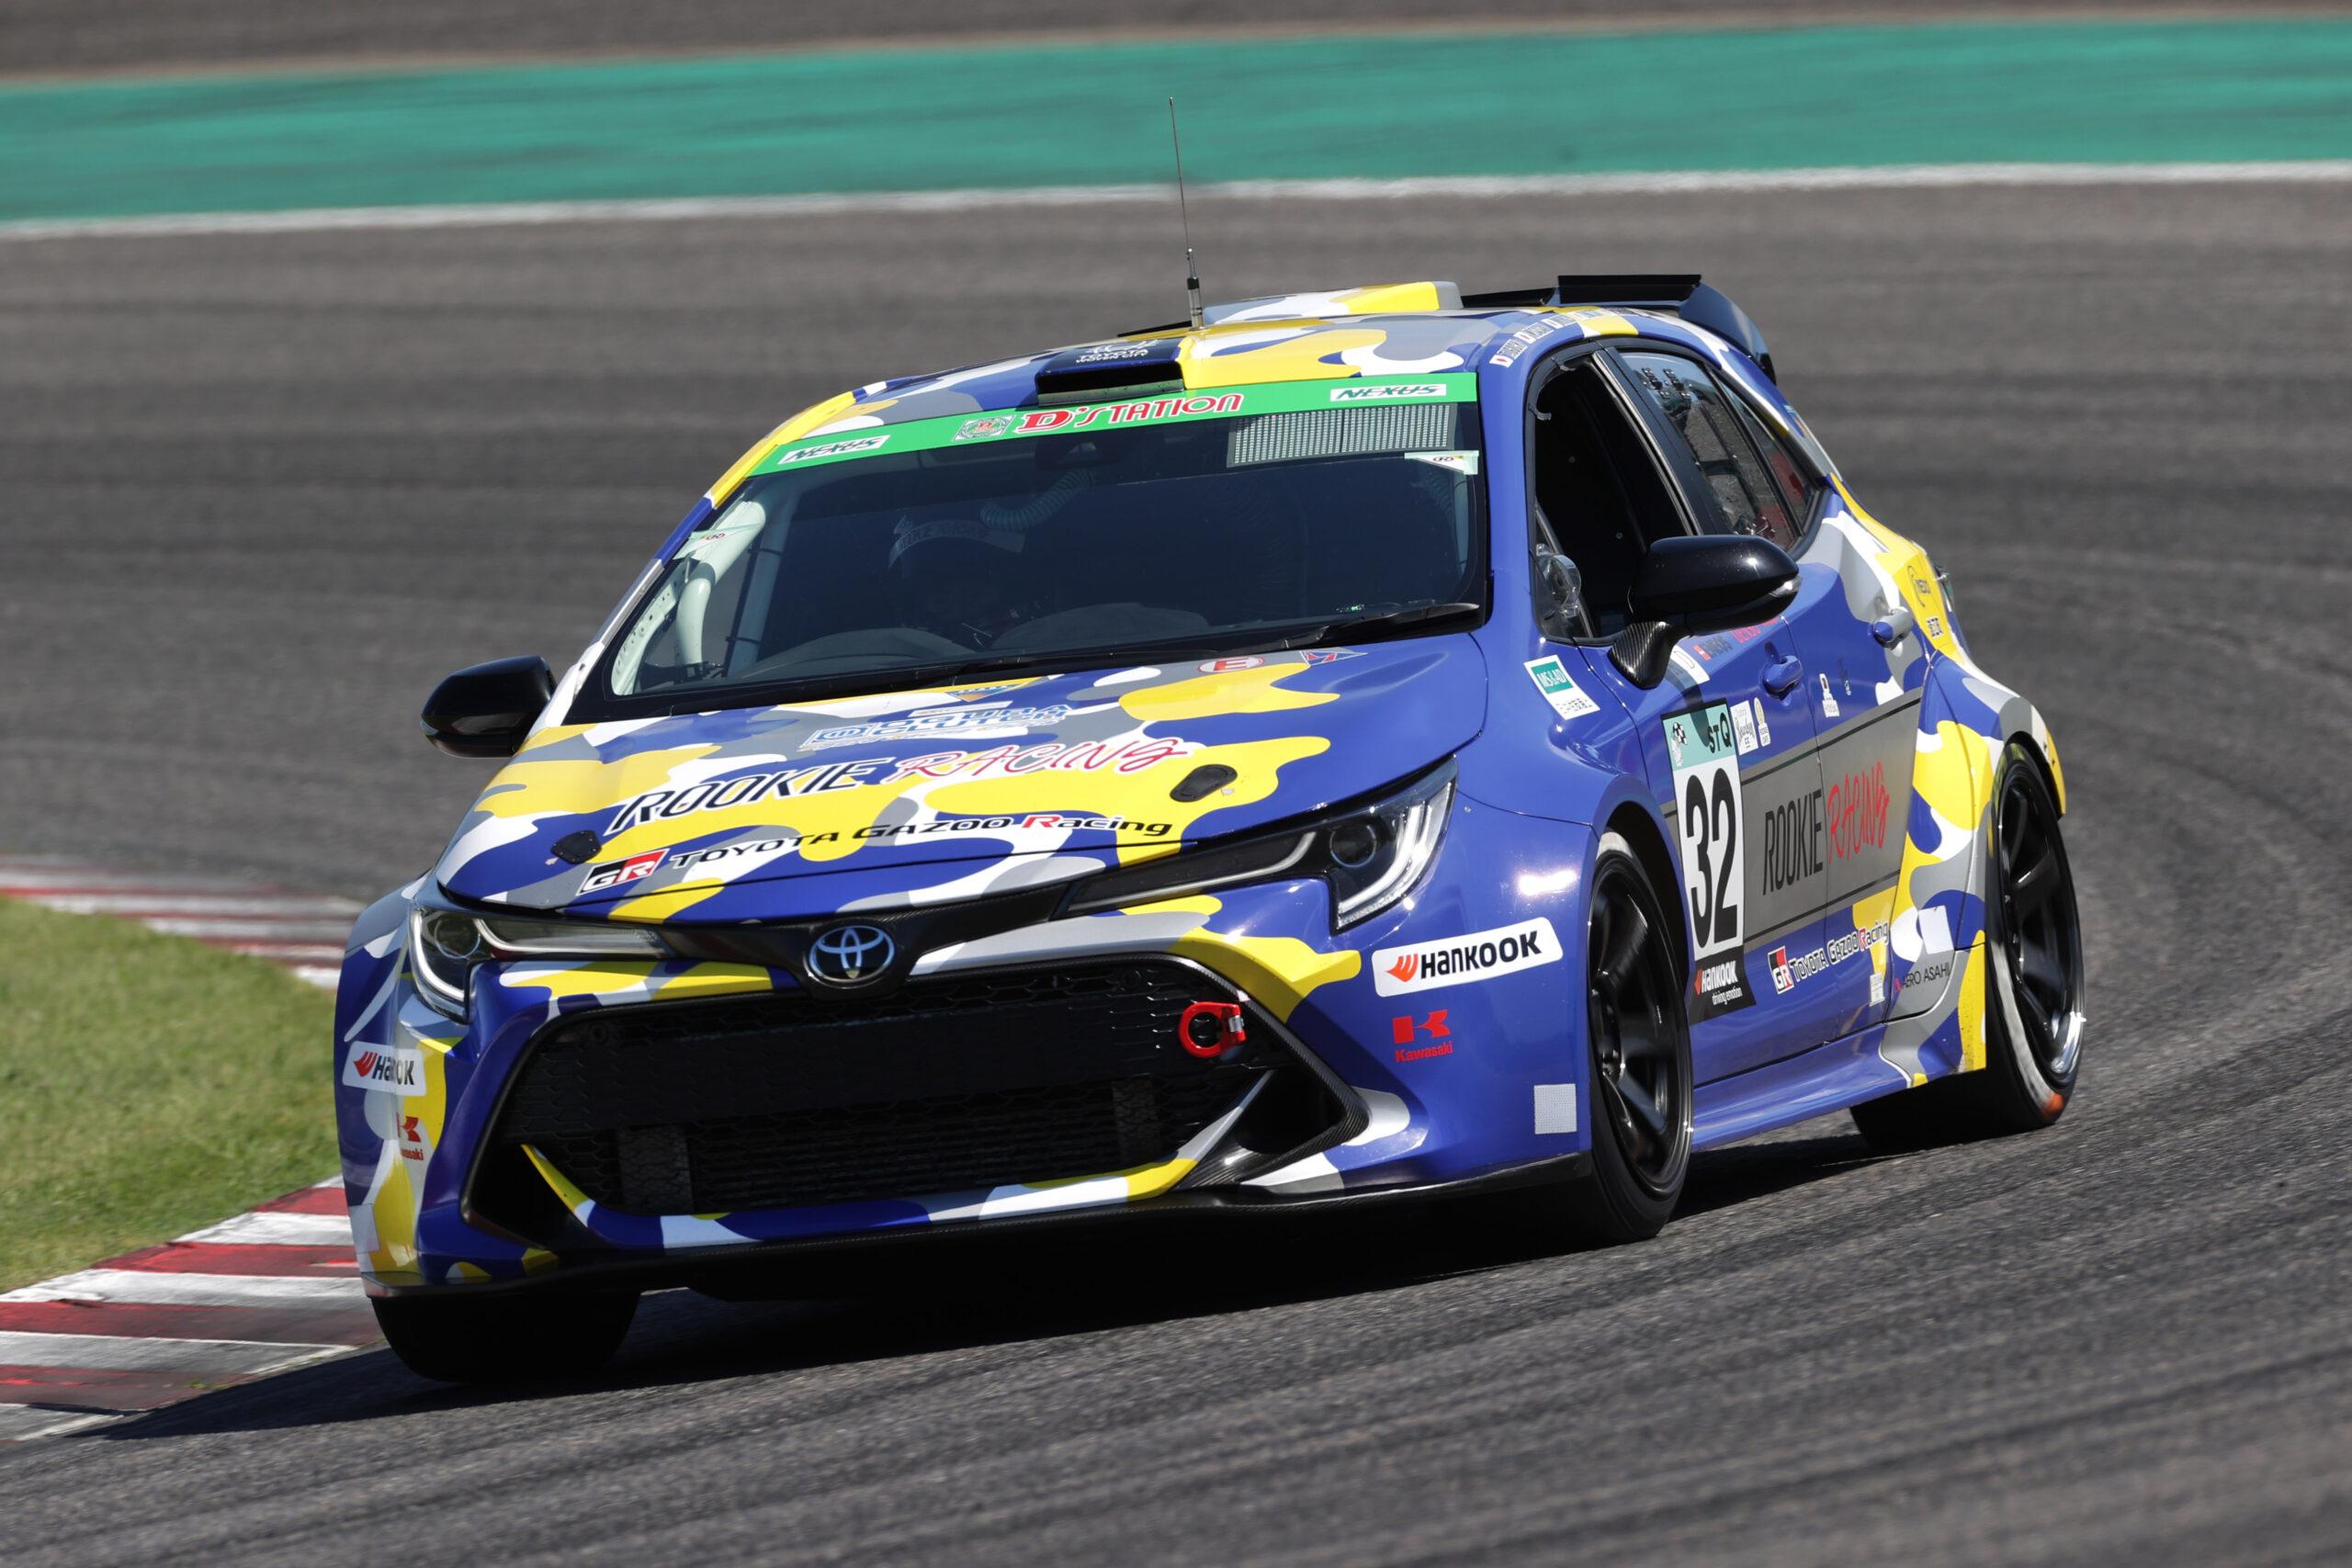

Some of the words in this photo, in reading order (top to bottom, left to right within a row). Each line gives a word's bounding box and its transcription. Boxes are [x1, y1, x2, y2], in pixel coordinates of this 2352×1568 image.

[1335, 386, 1439, 400] NEXUS
[784, 436, 884, 462] NEXUS
[1536, 669, 1567, 688] MS&AD
[609, 759, 892, 832] ROOKIE
[886, 739, 1188, 781] RACING
[582, 862, 659, 893] GR
[673, 831, 840, 868] TOYOTA
[853, 817, 1014, 839] GAZOO
[1021, 815, 1173, 837] Racing
[1686, 768, 1737, 949] 32
[1762, 788, 1824, 896] ROOKIE
[1826, 761, 1890, 864] RACING
[1789, 947, 1828, 982] TOYOTA
[1827, 931, 1859, 964] GAZOO
[1859, 920, 1889, 952] Racing
[1396, 1040, 1454, 1062] Kawasaki
